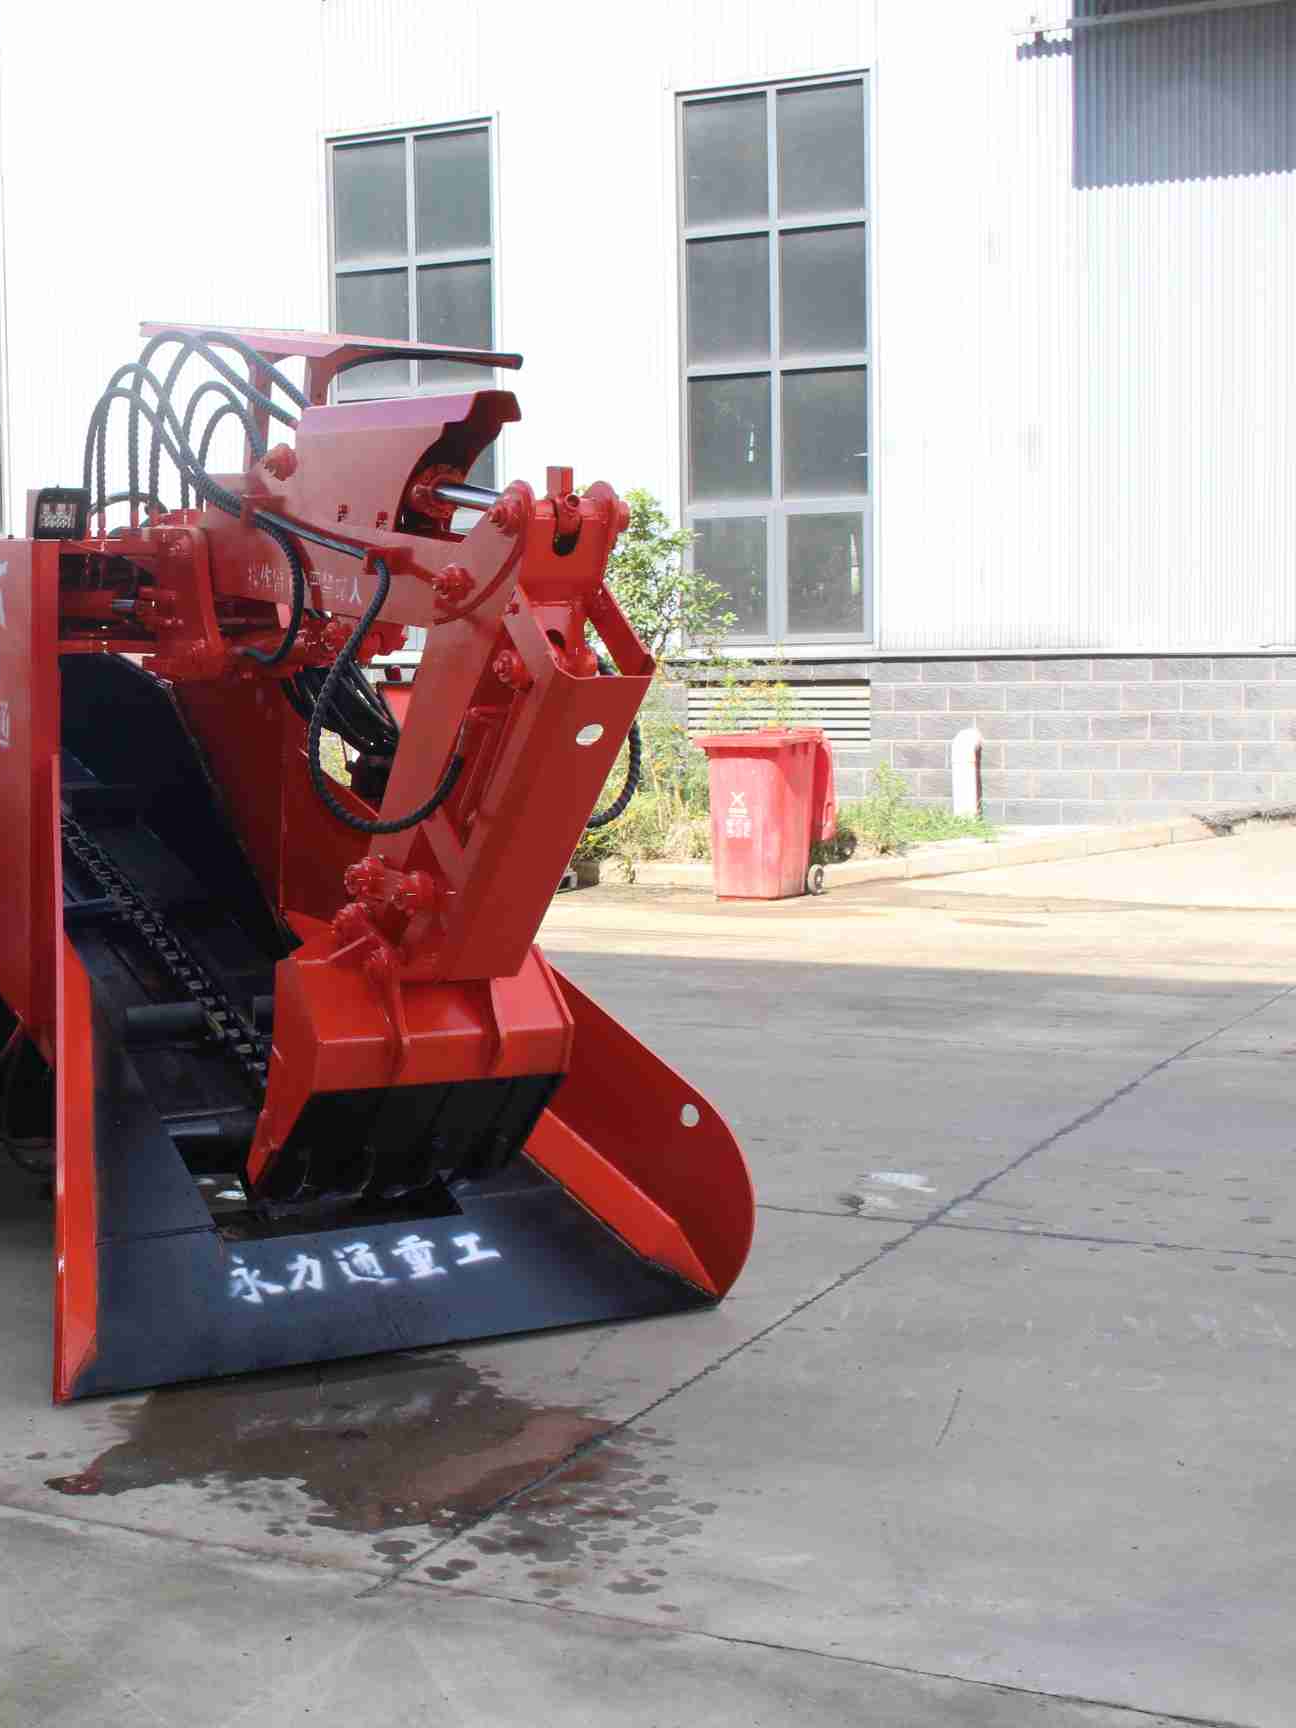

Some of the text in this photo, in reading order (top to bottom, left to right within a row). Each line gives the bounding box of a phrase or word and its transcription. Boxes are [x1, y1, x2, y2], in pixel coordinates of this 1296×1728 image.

[229, 1232, 503, 1304] 永力通重工
